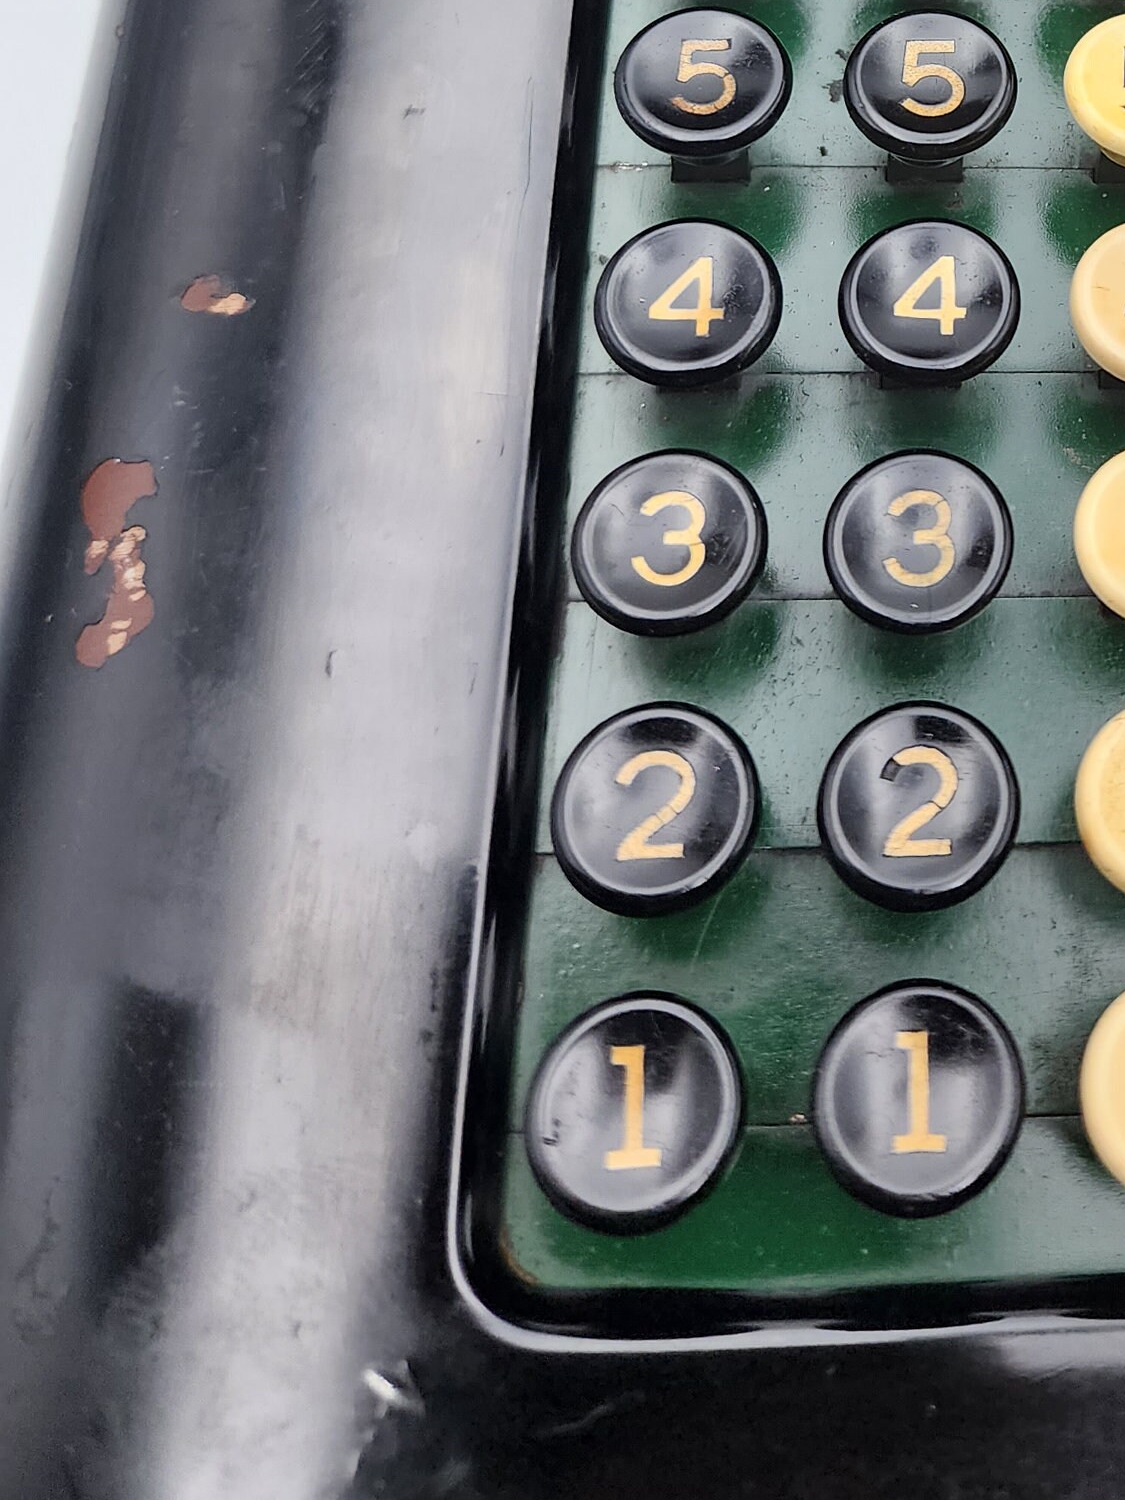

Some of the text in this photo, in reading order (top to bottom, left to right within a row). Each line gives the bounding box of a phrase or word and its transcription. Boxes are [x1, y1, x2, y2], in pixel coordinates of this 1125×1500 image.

[670, 38, 736, 114] 5
[900, 40, 965, 117] 5
[648, 256, 724, 338] 4
[893, 256, 967, 335] 4
[631, 489, 706, 586] 3
[884, 489, 955, 588] 3
[615, 750, 696, 862] 2
[880, 744, 958, 857] 2
[604, 1046, 662, 1170] 1
[892, 1031, 947, 1154] 1
